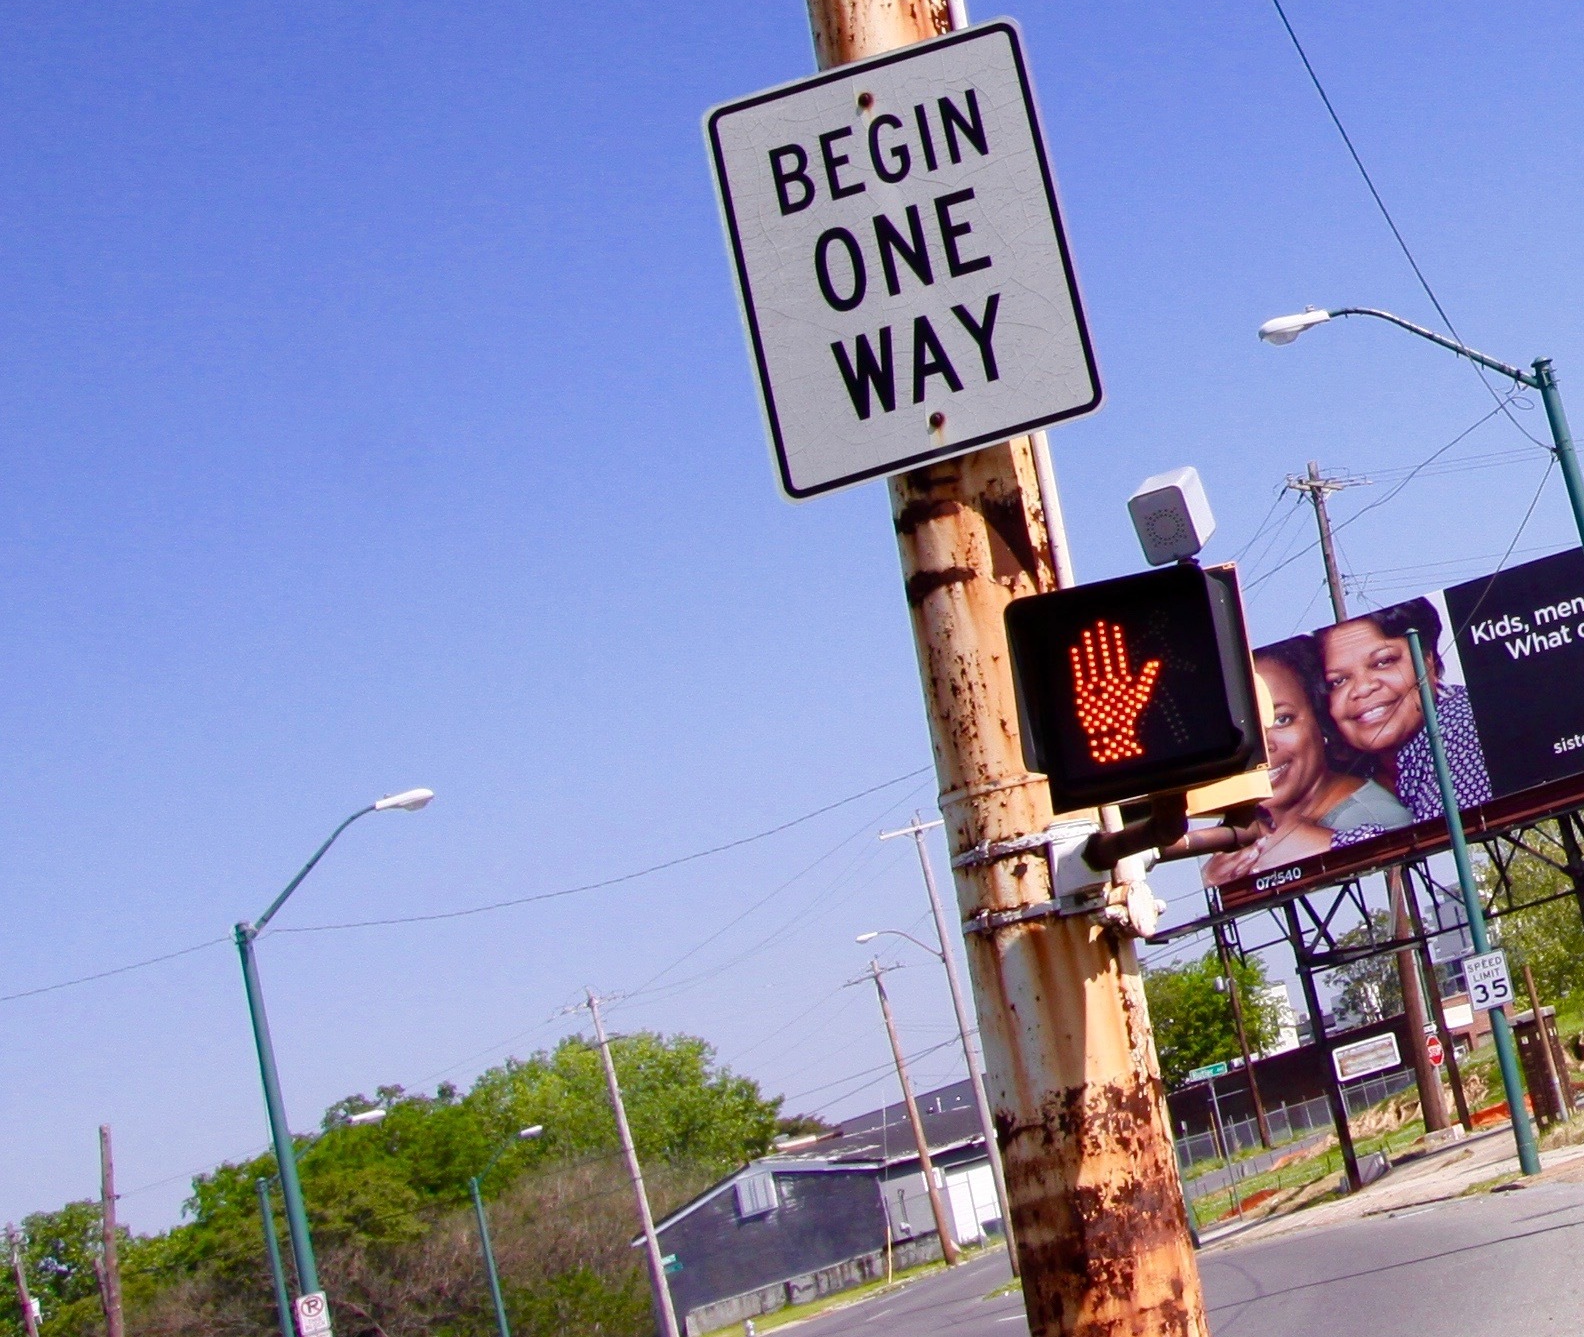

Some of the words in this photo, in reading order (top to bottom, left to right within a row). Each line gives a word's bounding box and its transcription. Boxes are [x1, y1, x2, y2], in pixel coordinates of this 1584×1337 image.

[768, 89, 989, 215] BEGIN
[814, 187, 992, 311] ONE
[830, 293, 1000, 420] WAY
[1470, 612, 1530, 645] Kids,
[1504, 625, 1573, 661] What
[1466, 956, 1502, 973] SPEED
[1473, 967, 1500, 982] LIMIT
[1474, 977, 1508, 1003] 35
